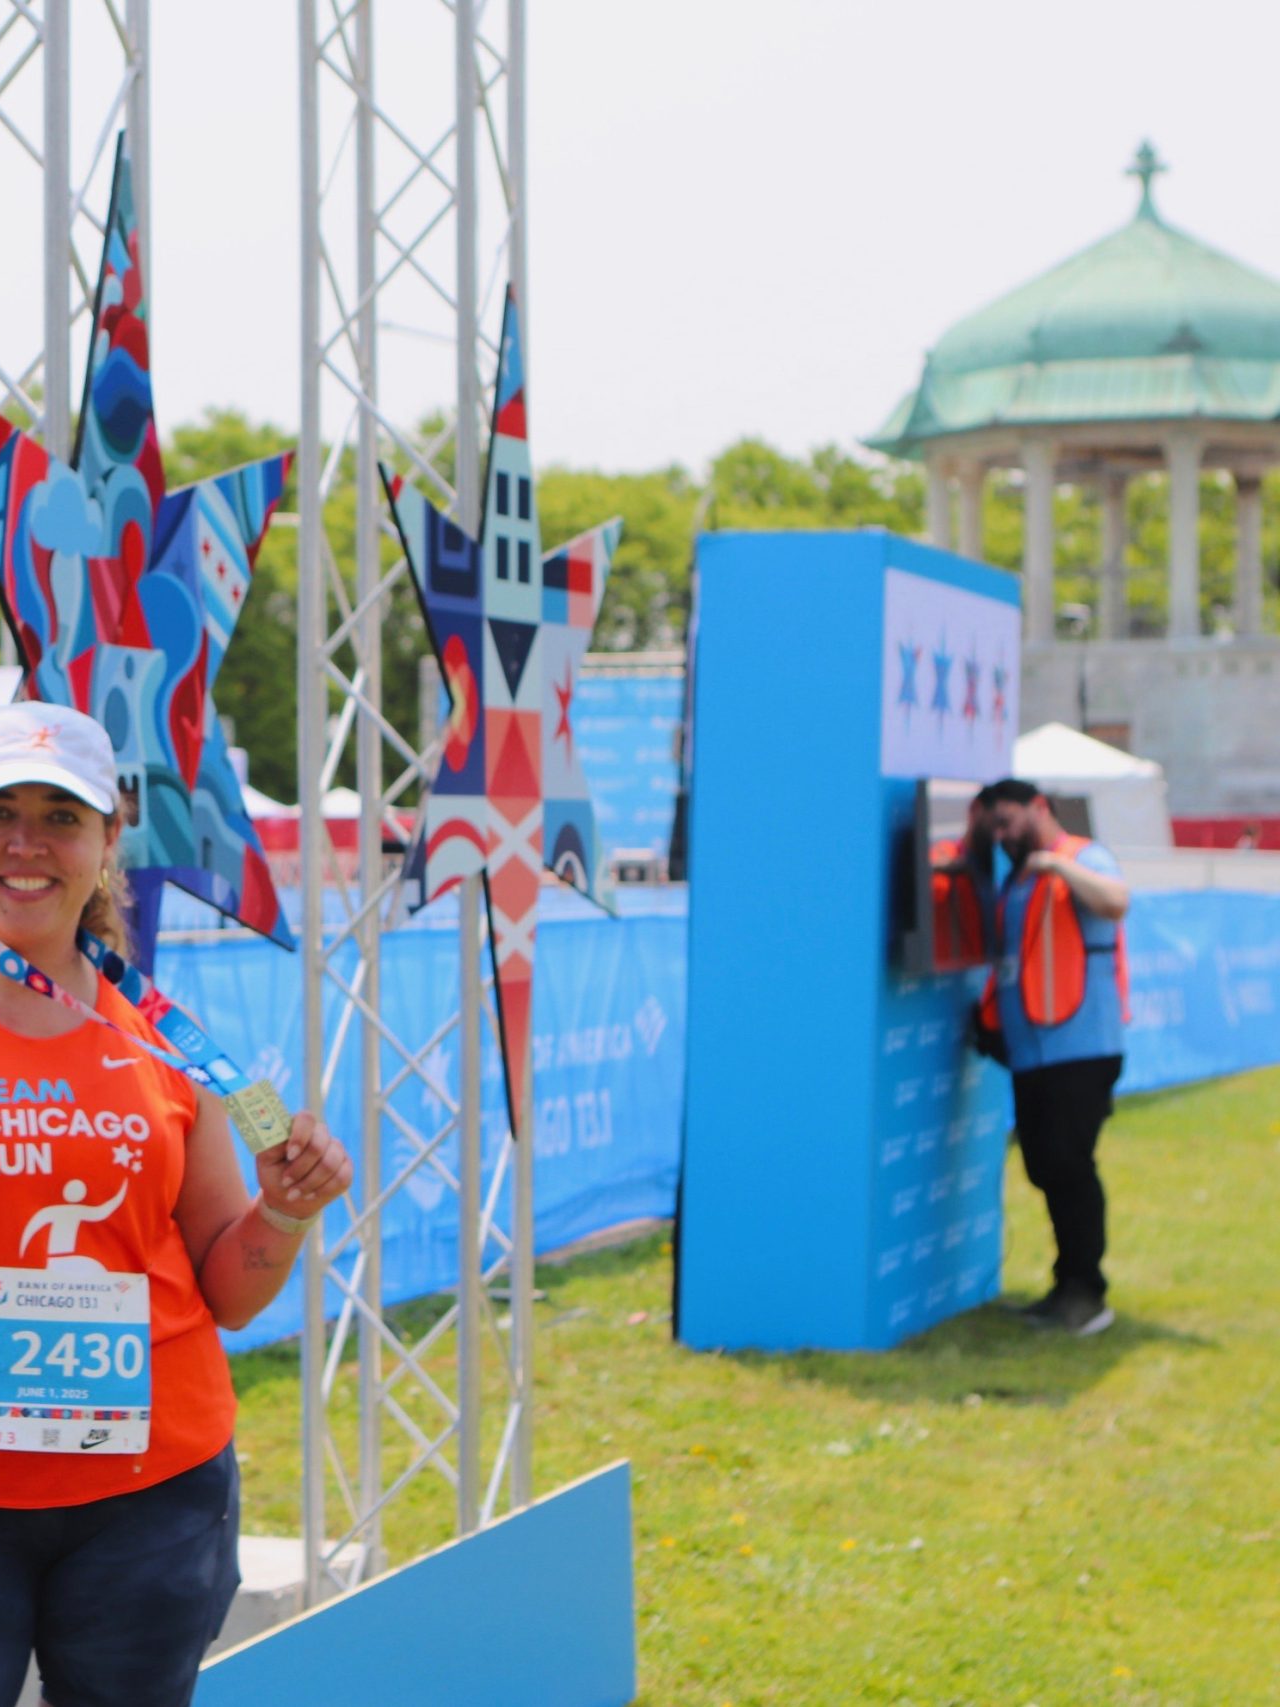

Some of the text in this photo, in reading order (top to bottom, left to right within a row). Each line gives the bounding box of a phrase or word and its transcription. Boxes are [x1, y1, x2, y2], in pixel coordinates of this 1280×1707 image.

[17, 1281, 111, 1292] BANK OF AMERICA
[16, 1294, 74, 1308] CHICAGO
[9, 1330, 145, 1379] 2430
[16, 1387, 89, 1399] JUNE 1, 2025
[6, 1432, 16, 1444] 3
